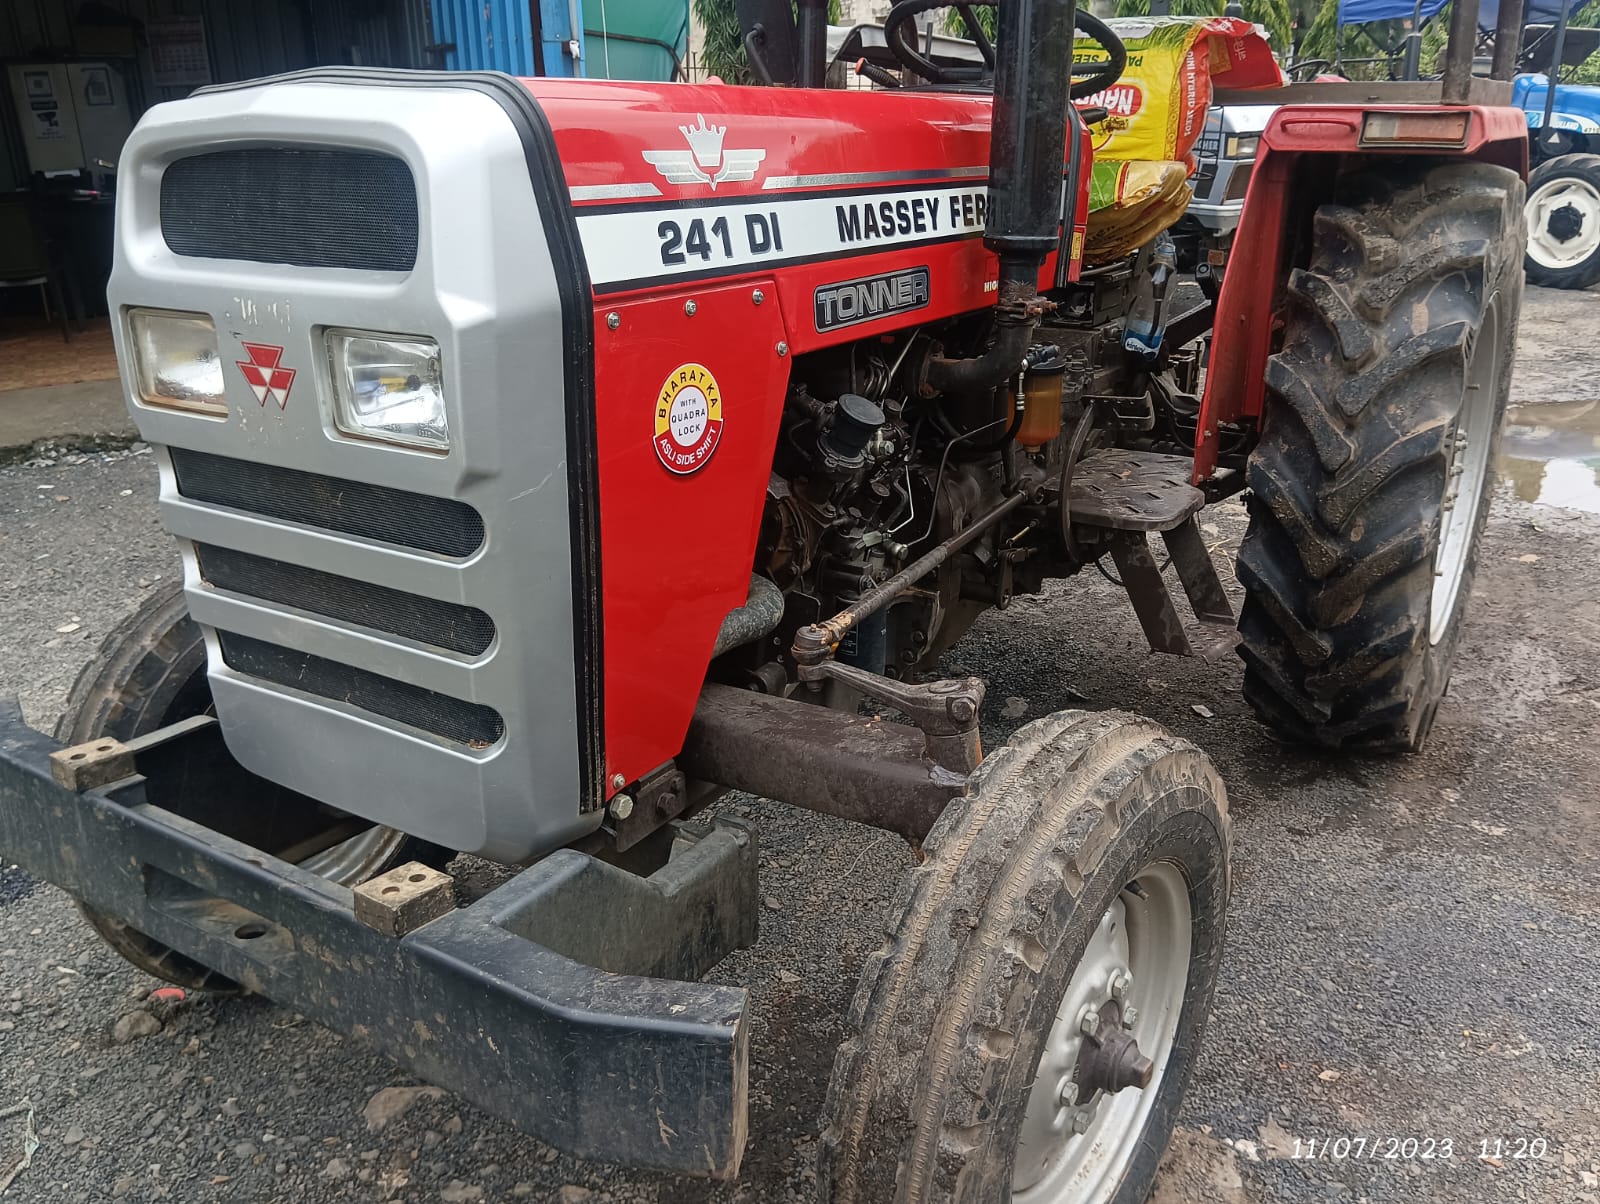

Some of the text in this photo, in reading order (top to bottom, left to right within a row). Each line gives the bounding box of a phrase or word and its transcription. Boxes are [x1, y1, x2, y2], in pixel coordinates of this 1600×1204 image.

[1187, 72, 1196, 108] HYBRID
[835, 193, 987, 243] MASSEY FER
[657, 212, 783, 266] 241 DI
[817, 272, 927, 325] TONNER
[658, 369, 718, 419] BHARAT KA
[680, 398, 697, 408] WITH
[671, 408, 706, 424] QUADRA
[678, 423, 701, 437] LOCK
[660, 426, 716, 466] ASLI SIDE SHIFT
